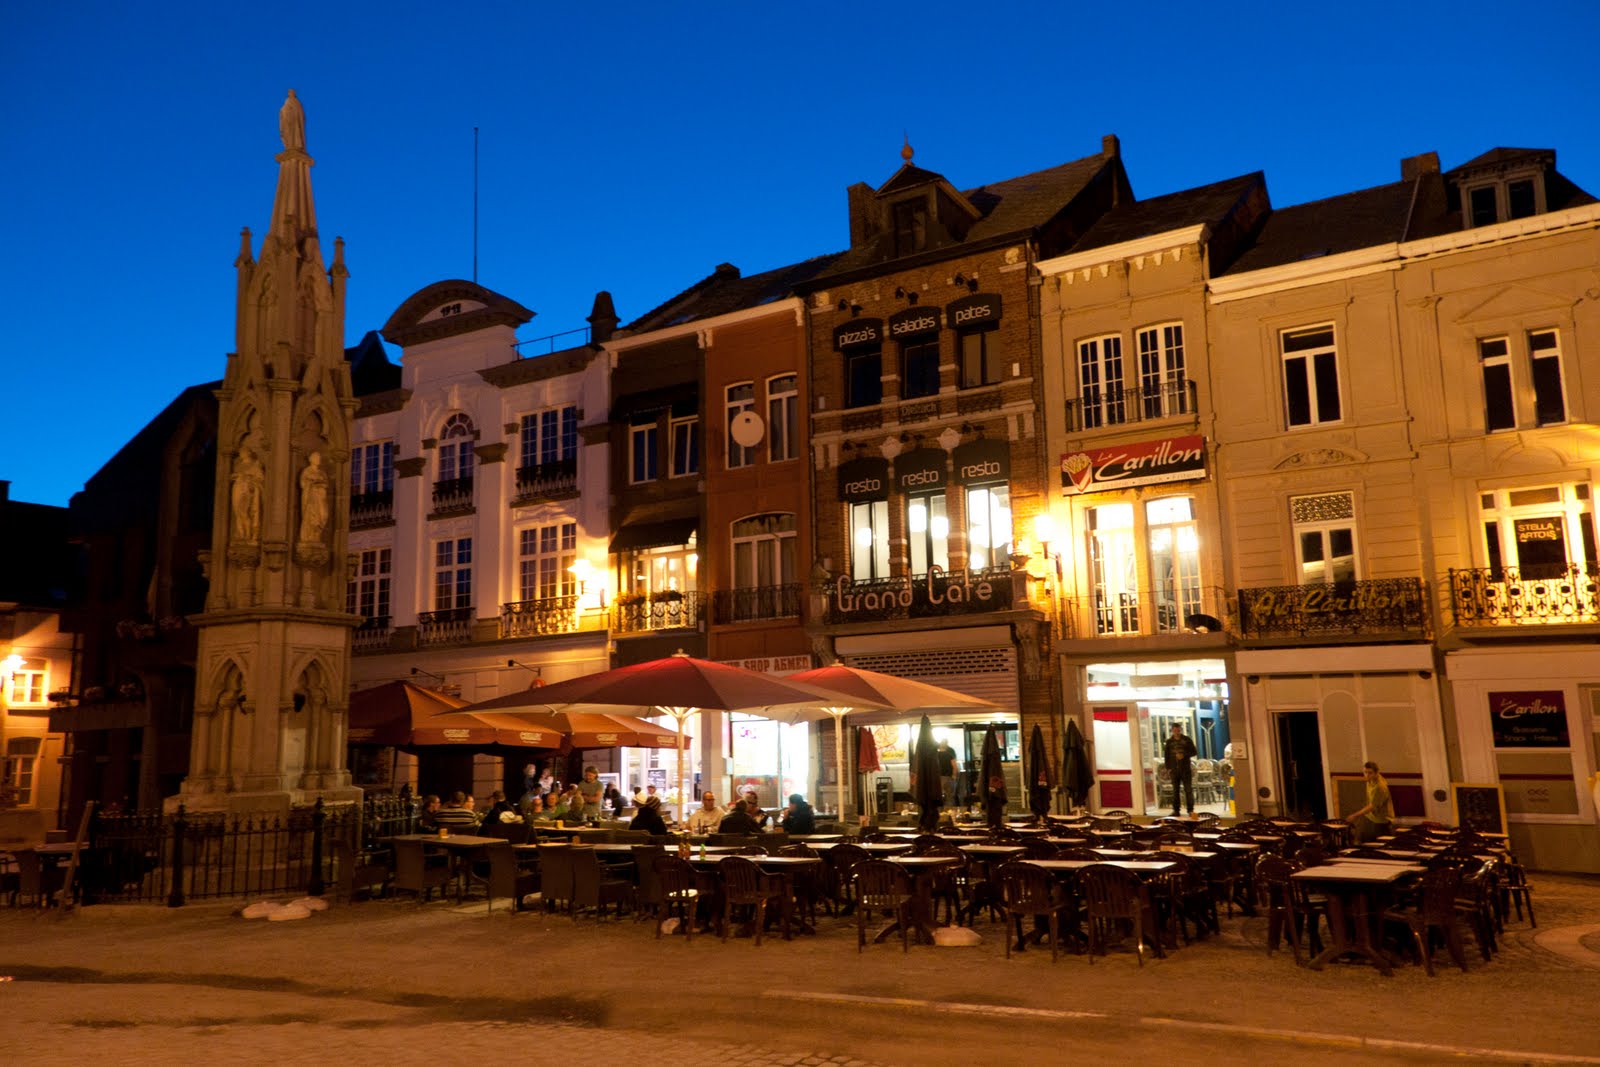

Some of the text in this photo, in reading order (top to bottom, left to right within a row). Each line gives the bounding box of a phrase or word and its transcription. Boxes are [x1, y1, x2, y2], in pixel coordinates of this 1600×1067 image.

[955, 304, 991, 324] pates
[892, 316, 936, 335] salades
[839, 326, 876, 348] pizza's
[961, 460, 1000, 479] resto
[1094, 441, 1201, 481] Carillon
[845, 477, 881, 495] resto
[902, 469, 939, 486] resto
[1518, 522, 1554, 532] STELLA
[1520, 530, 1557, 540] ARTOIS
[836, 567, 914, 612] Grand
[1300, 585, 1407, 613] Carillon
[743, 659, 770, 672] SHOP
[1500, 699, 1557, 719] Carillon
